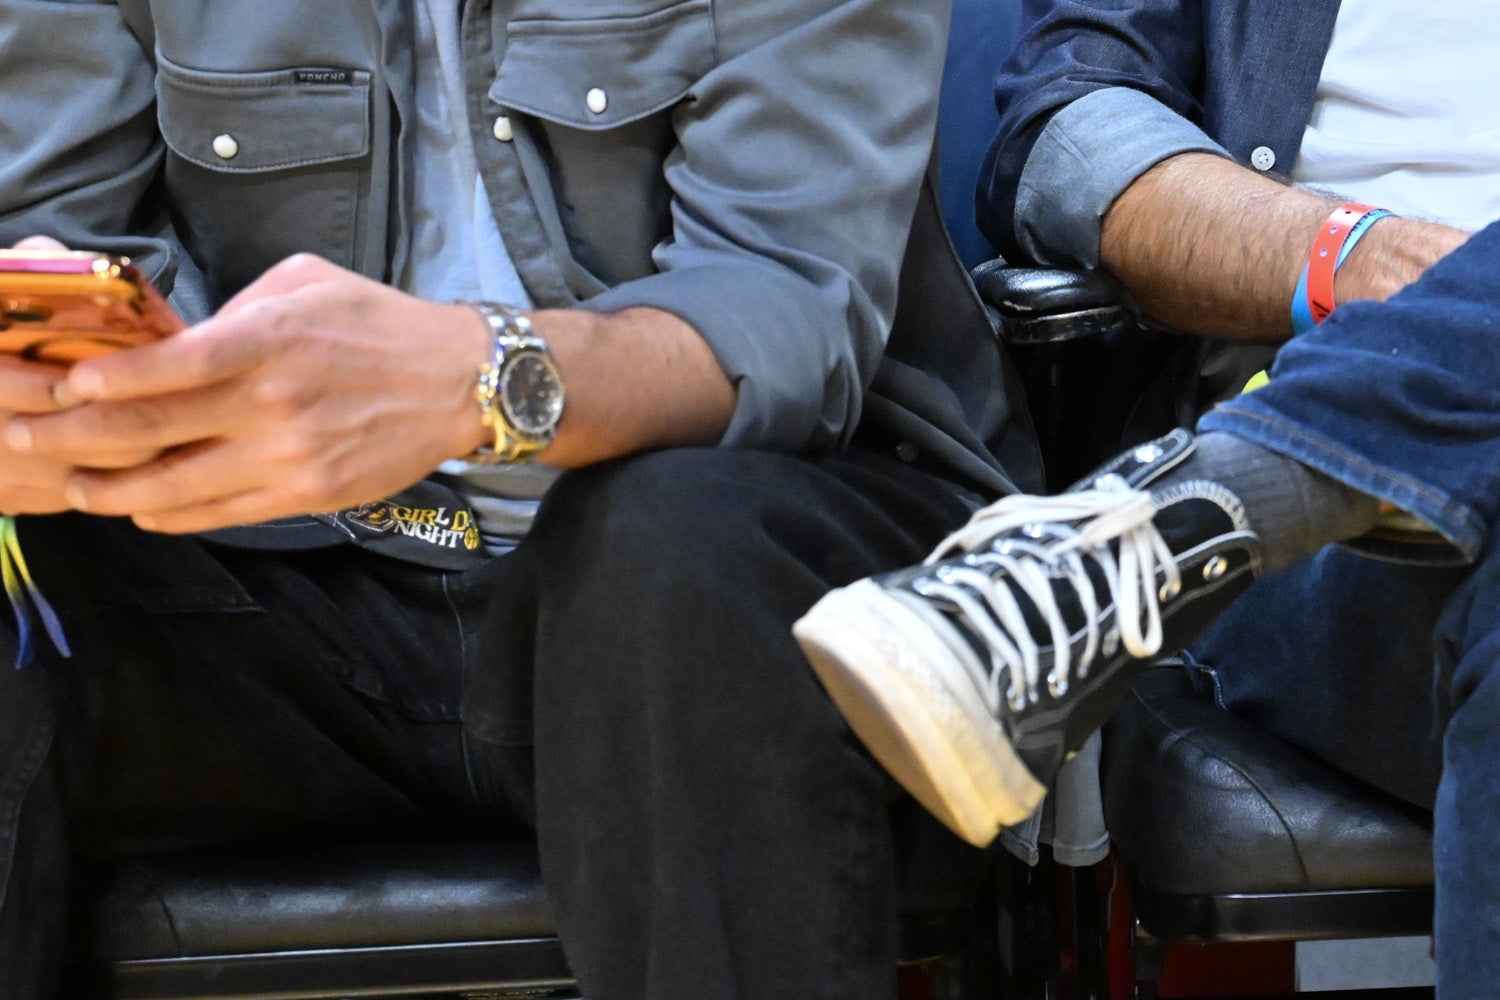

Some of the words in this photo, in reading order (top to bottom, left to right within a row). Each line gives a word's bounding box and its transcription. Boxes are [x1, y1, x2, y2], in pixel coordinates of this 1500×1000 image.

[299, 72, 346, 82] PONCHO
[392, 506, 450, 527] GIRL
[393, 520, 465, 549] NIGHT
